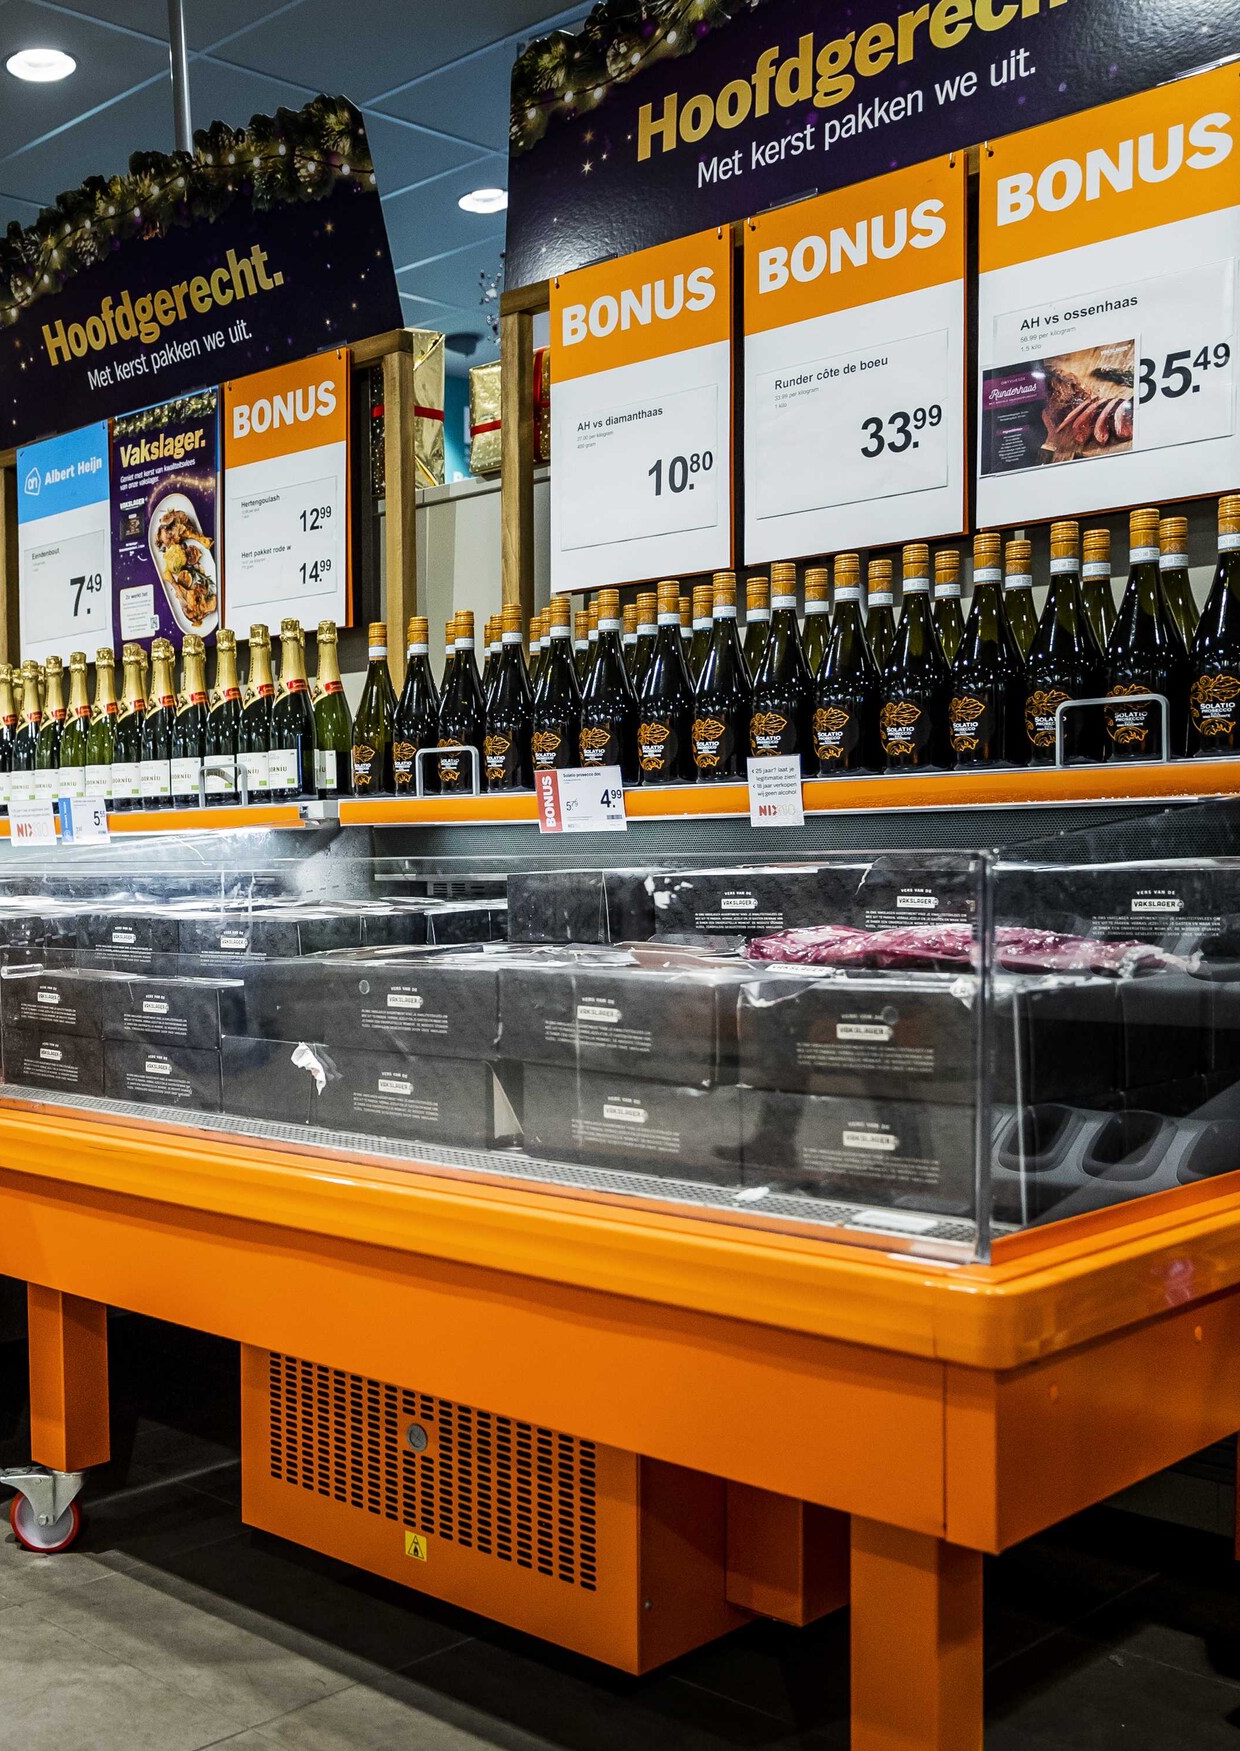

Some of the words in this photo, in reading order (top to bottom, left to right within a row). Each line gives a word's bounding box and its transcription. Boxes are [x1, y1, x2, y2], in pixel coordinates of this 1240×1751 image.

[697, 150, 743, 188] Met
[751, 124, 815, 167] kerst
[824, 88, 923, 151] pakken
[934, 70, 977, 106] we
[989, 47, 1036, 87] uit.
[996, 112, 1233, 227] BONUS
[758, 198, 946, 295] BONUS
[41, 244, 284, 366] Hoofdgerecht.
[562, 266, 716, 347] BONUS
[1020, 316, 1040, 331] AH
[1044, 313, 1059, 325] vs
[1063, 296, 1138, 321] ossenhaas
[87, 366, 113, 391] Met
[115, 352, 148, 381] kerst
[151, 338, 200, 376] pakken
[203, 330, 225, 350] we
[228, 320, 252, 342] uit.
[774, 373, 814, 390] Runder
[816, 367, 840, 381] côte
[843, 363, 856, 374] de
[859, 356, 888, 372] boeu
[232, 380, 336, 439] BONUS
[577, 422, 591, 432] AH
[592, 420, 603, 429] vs
[605, 407, 663, 426] diamanthaas
[44, 464, 75, 485] Albert
[78, 456, 102, 475] Heijn
[120, 428, 206, 468] Vakslager.
[241, 495, 280, 508] Hertengoulash
[253, 547, 271, 557] pakket
[273, 545, 285, 553] rode
[542, 775, 556, 827] BONUS
